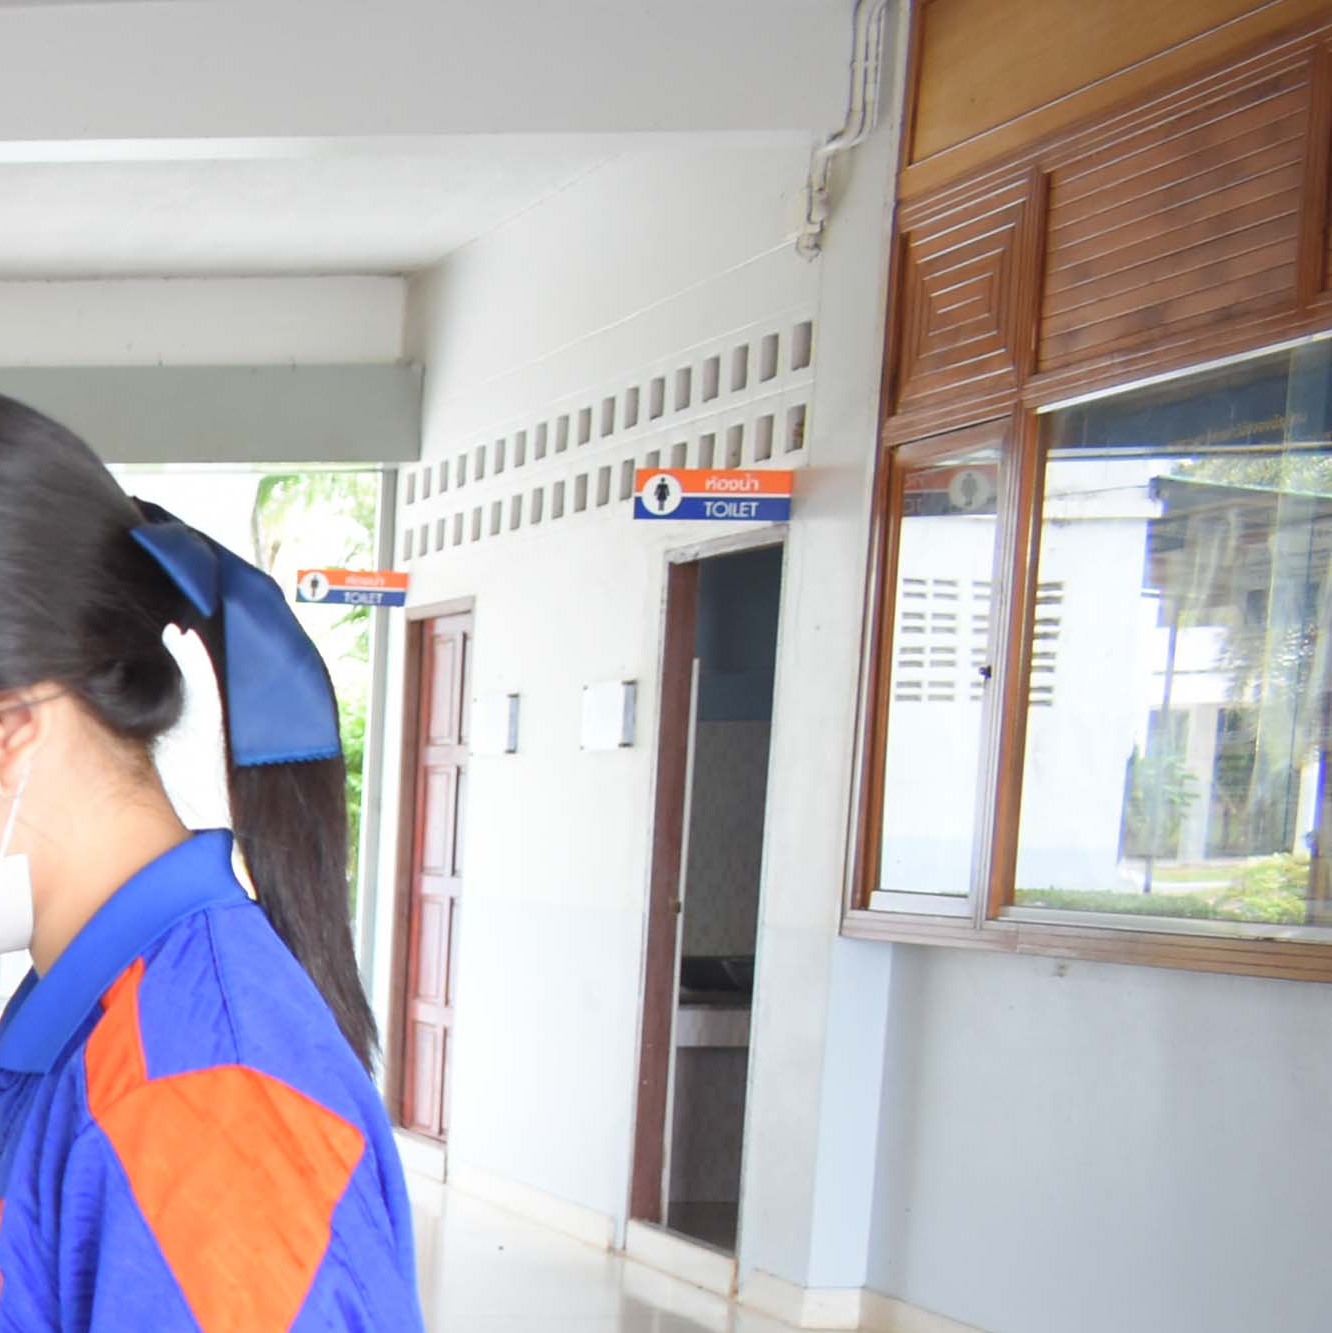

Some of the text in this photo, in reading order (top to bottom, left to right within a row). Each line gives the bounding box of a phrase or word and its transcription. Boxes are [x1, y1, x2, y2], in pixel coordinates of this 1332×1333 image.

[704, 472, 760, 491] ห้องน้ำ
[704, 501, 759, 518] TOILET
[344, 591, 383, 604] TOILET
